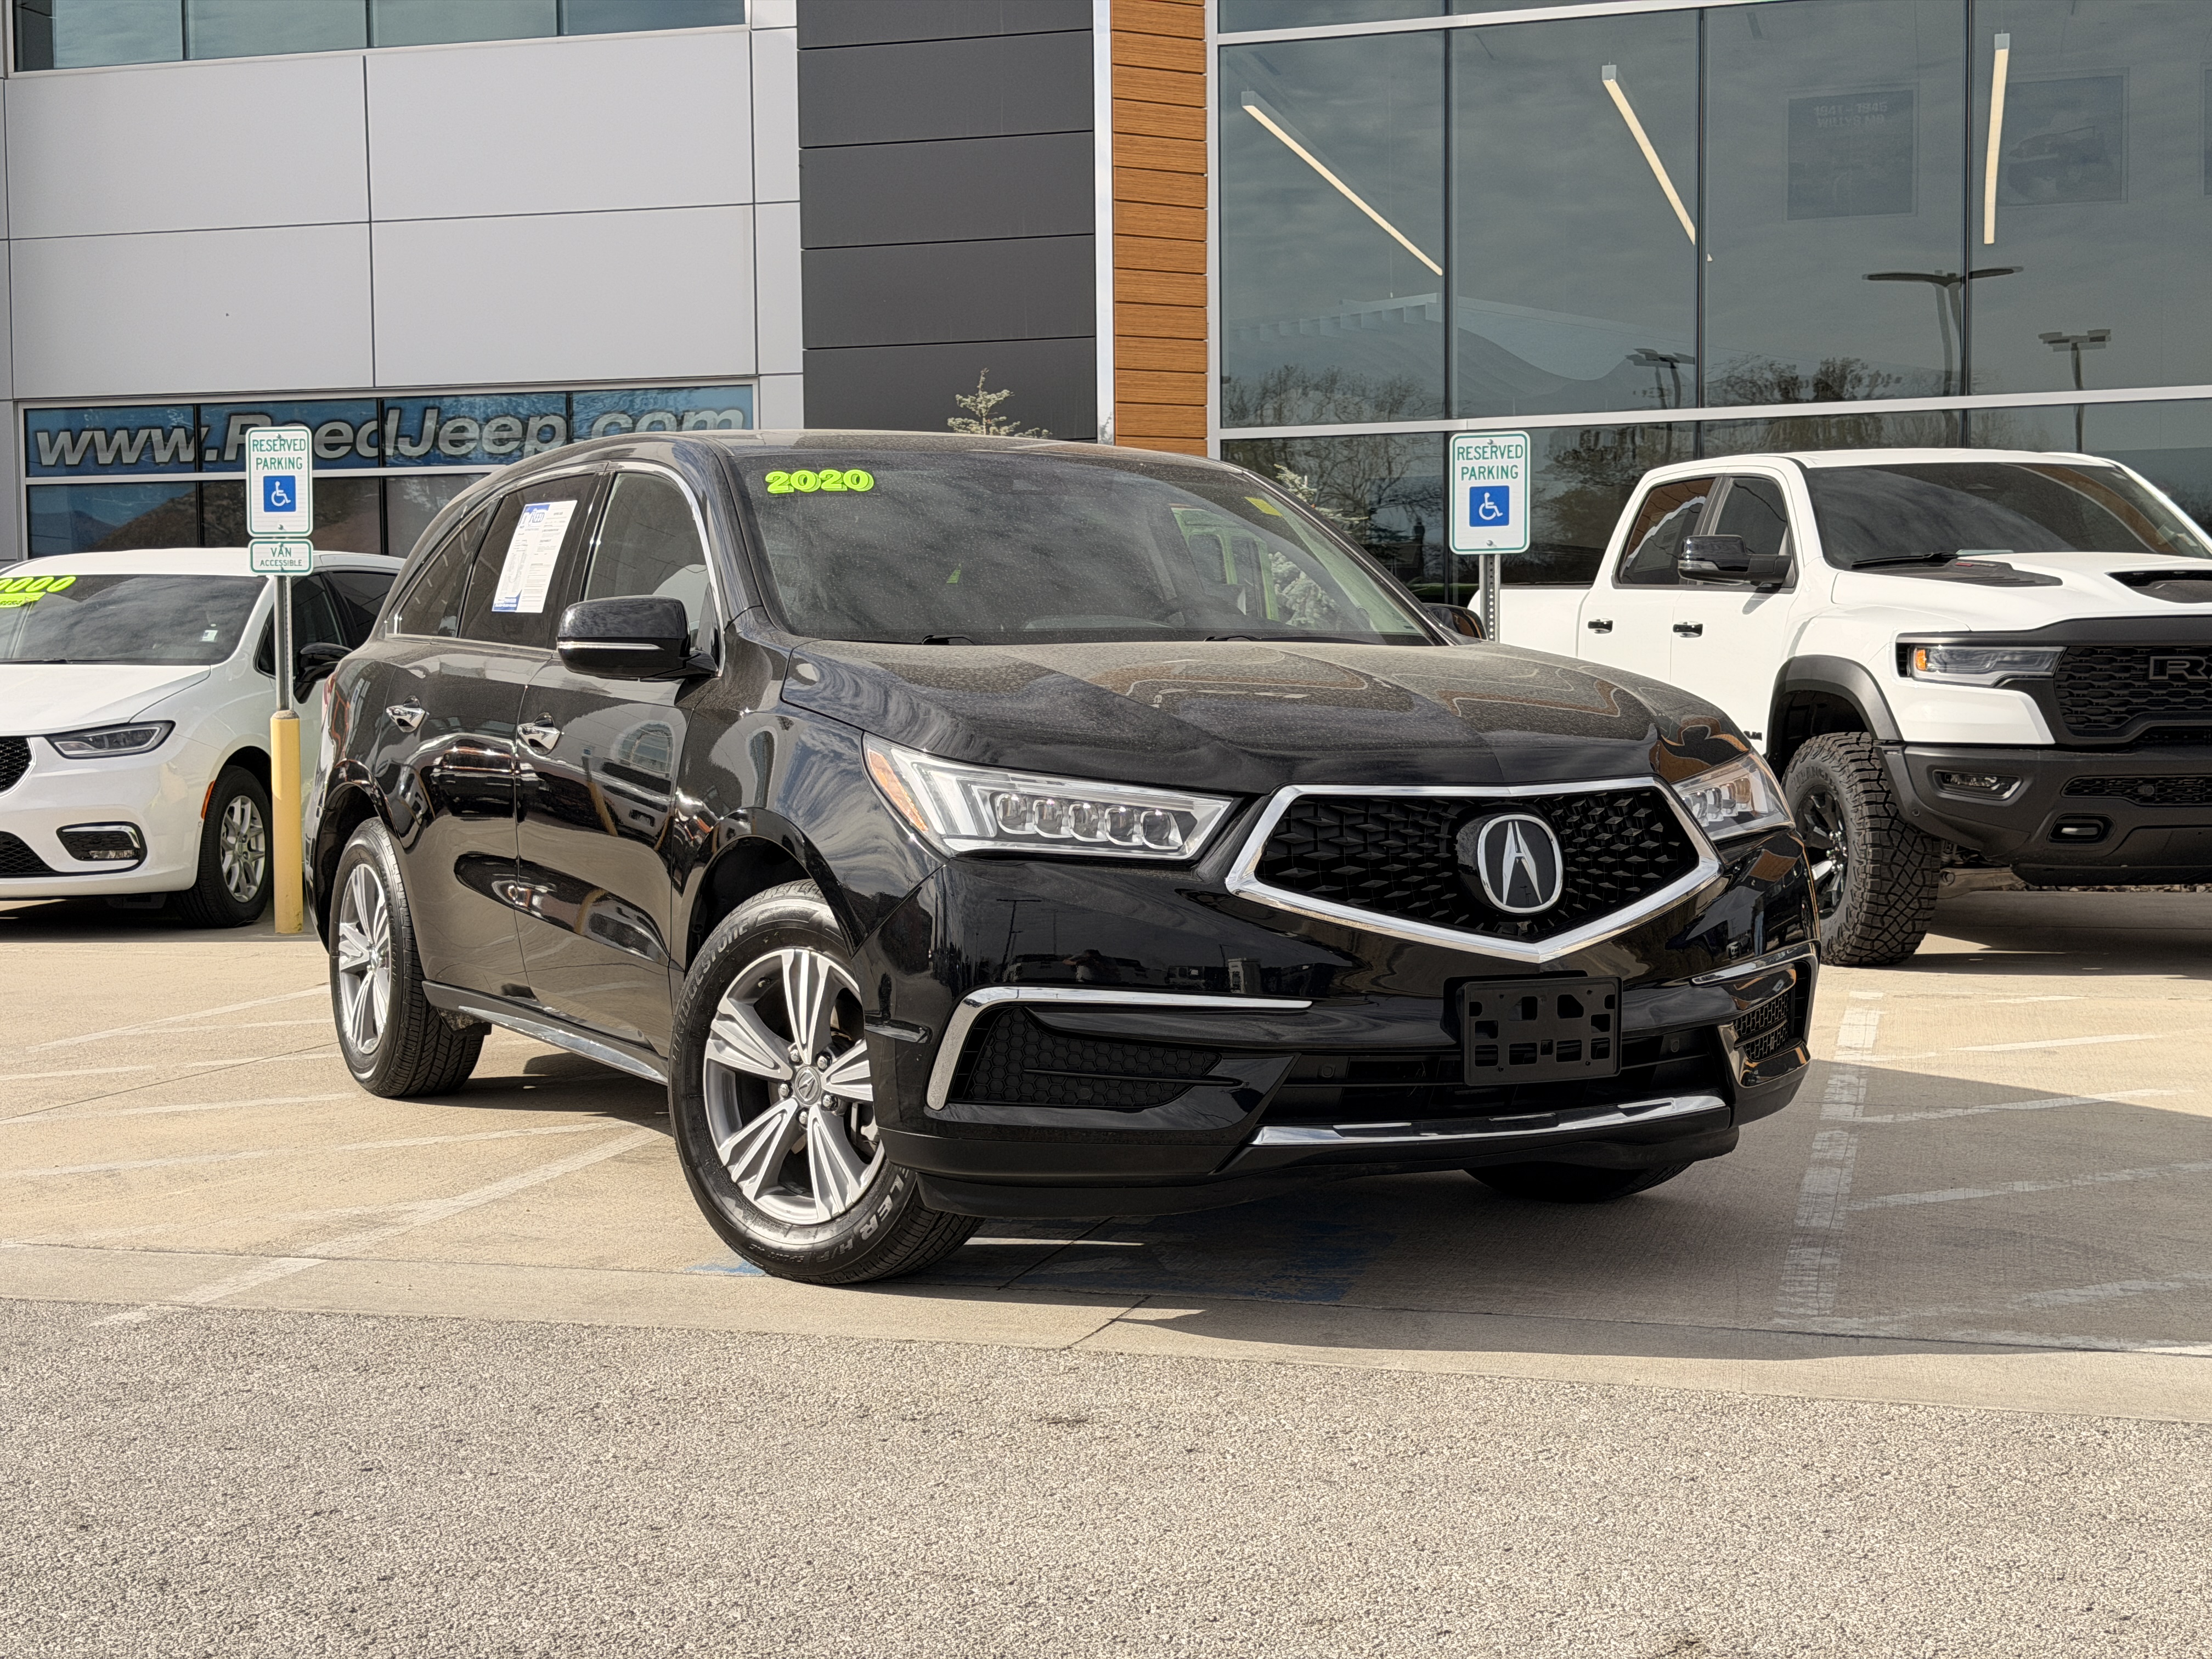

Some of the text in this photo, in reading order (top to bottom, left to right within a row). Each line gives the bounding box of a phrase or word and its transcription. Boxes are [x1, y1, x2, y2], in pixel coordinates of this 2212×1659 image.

[36, 408, 743, 466] www.RedJeepcom
[252, 438, 306, 452] RESERVED
[1457, 444, 1523, 461] RESERVED
[256, 456, 303, 470] PARKING
[1461, 465, 1519, 481] PARKING
[765, 469, 874, 494] 2020
[270, 548, 292, 557] VAN
[2149, 656, 2212, 680] R
